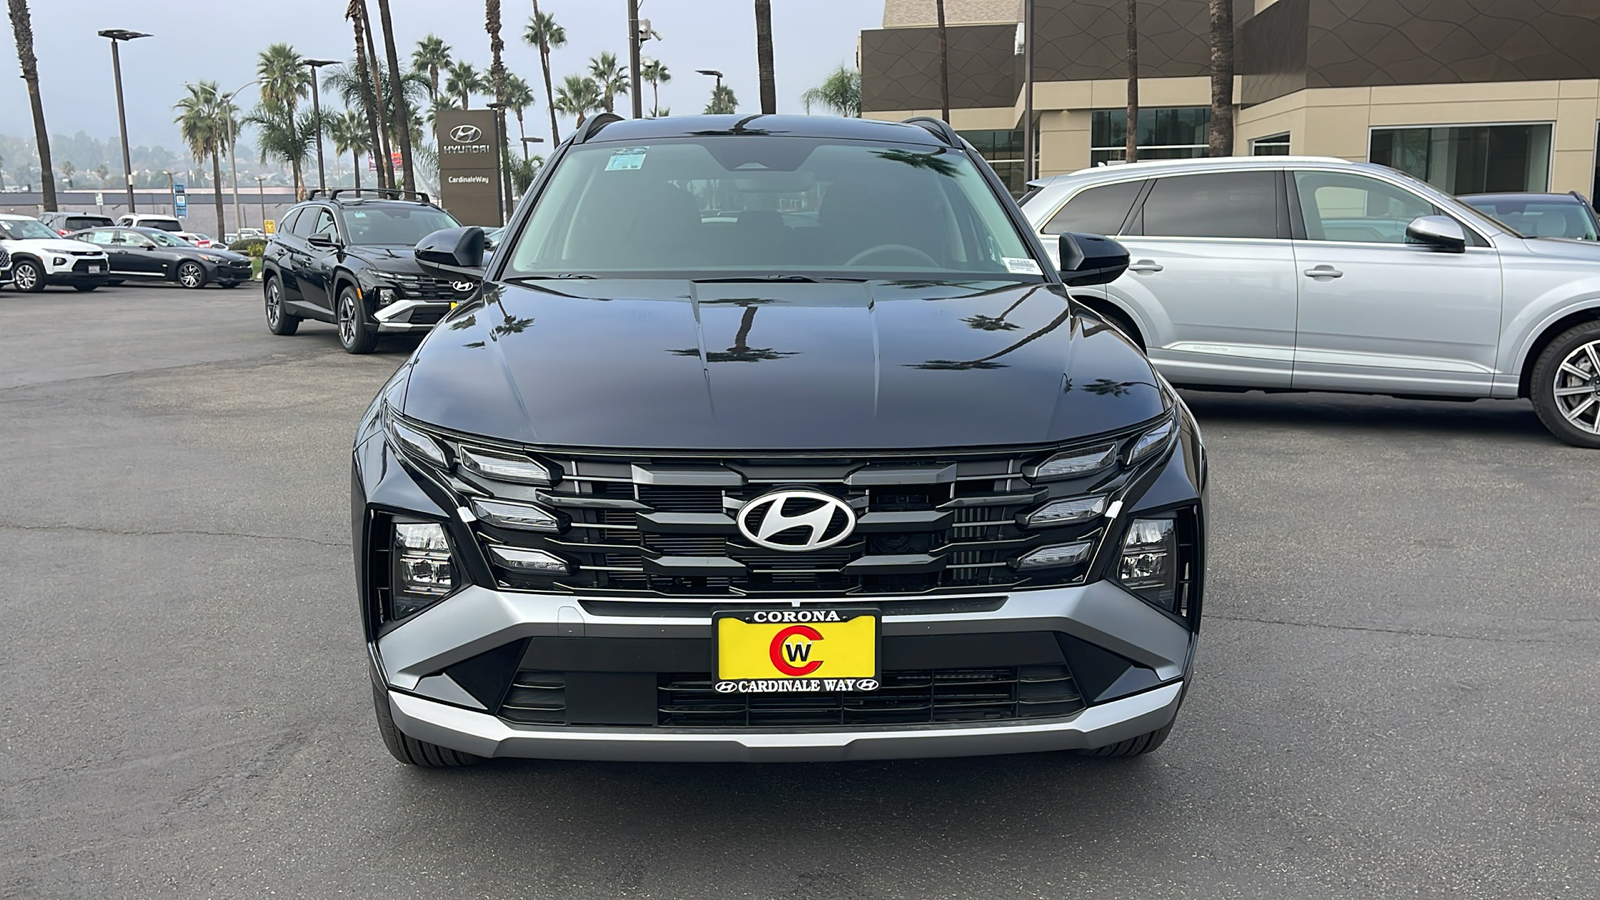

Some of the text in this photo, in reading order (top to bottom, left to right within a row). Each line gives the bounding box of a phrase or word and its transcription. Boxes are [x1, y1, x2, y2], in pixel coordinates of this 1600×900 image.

[443, 144, 490, 154] HYUNDAI
[448, 176, 489, 184] CardinaleWay
[753, 610, 840, 623] CORONA
[738, 678, 857, 693] CARDINALE WAY
